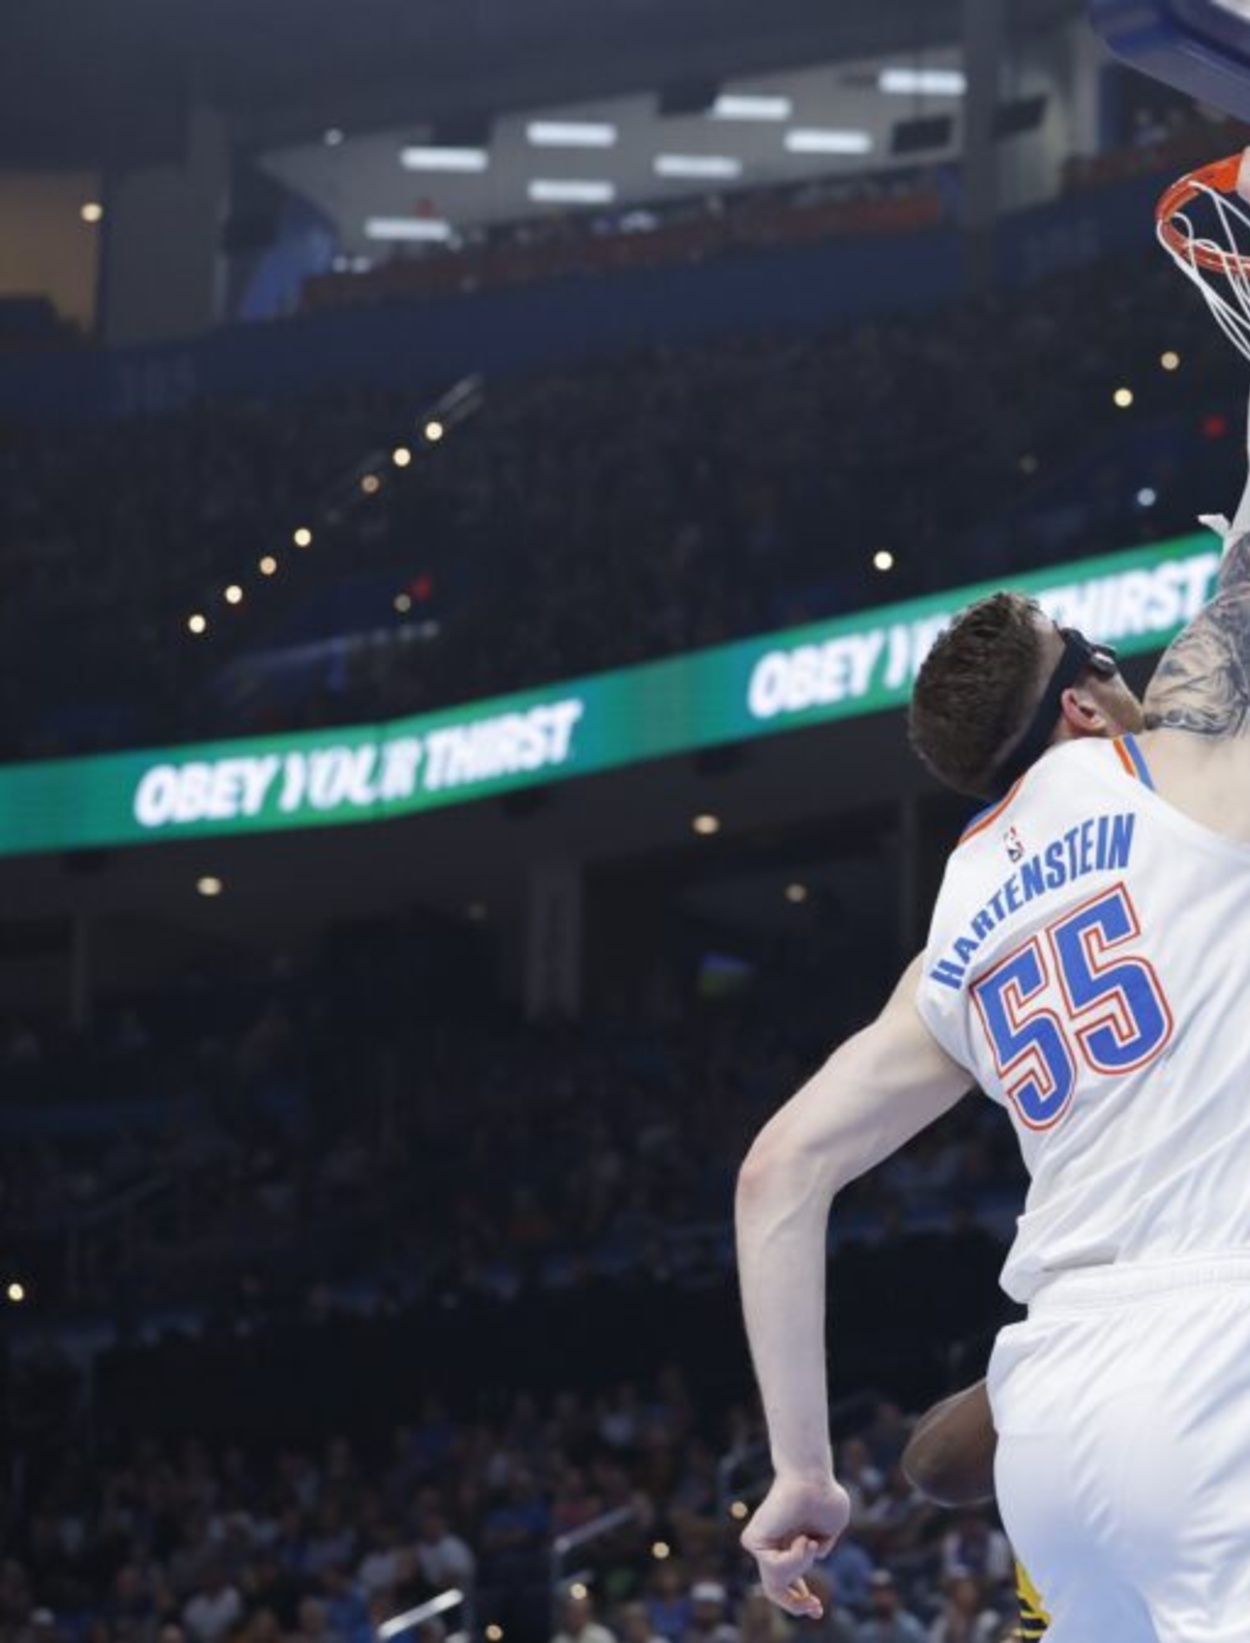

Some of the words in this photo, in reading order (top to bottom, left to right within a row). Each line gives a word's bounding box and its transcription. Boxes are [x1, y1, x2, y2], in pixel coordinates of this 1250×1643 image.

[748, 628, 885, 719] OBEY
[134, 755, 279, 827] OBEY
[424, 698, 584, 790] THIRST
[929, 812, 1136, 990] HARTENSTEIN
[968, 880, 1174, 1132] 55
